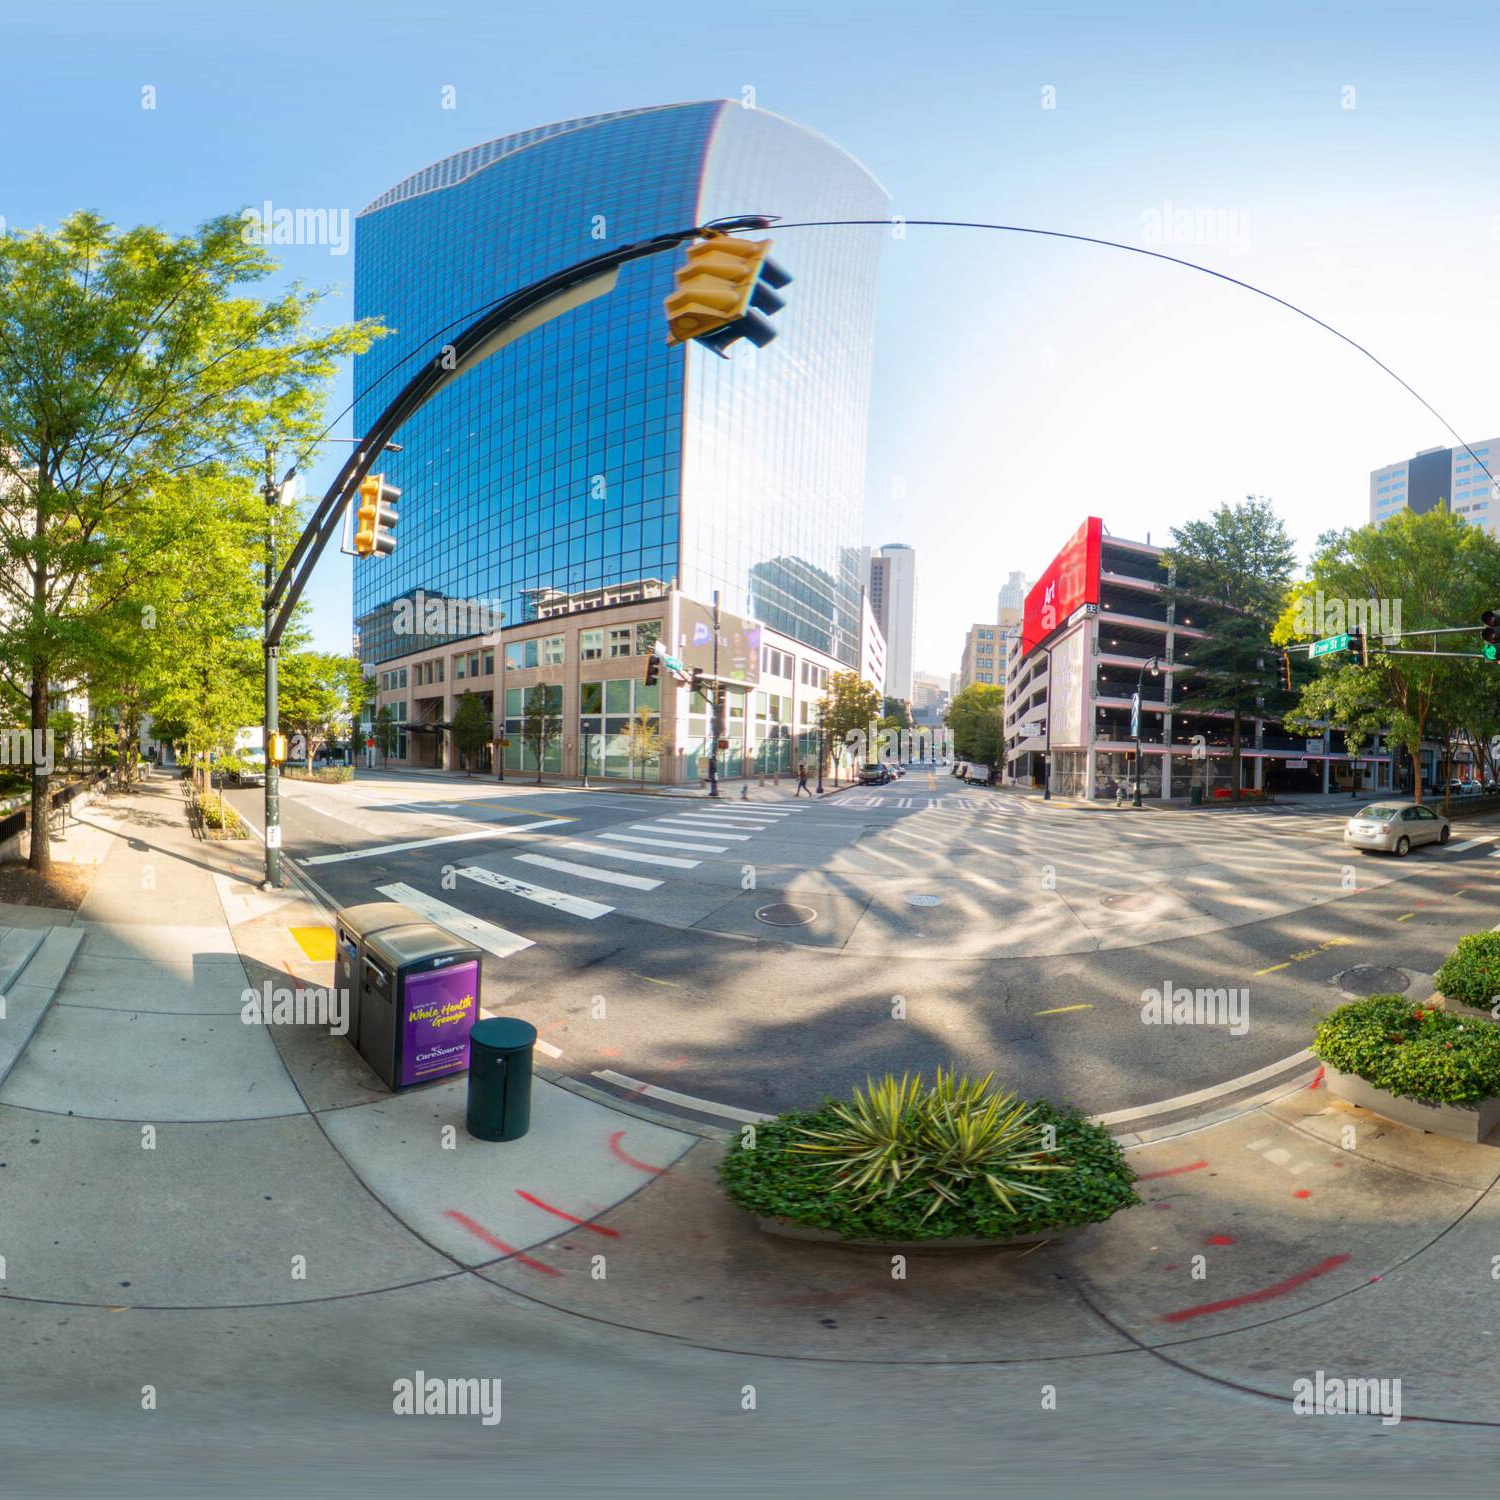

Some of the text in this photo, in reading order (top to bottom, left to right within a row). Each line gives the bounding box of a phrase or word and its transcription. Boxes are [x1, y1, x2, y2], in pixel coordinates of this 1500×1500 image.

[409, 995, 474, 1022] Whole Health
[416, 1044, 466, 1061] CareSource
